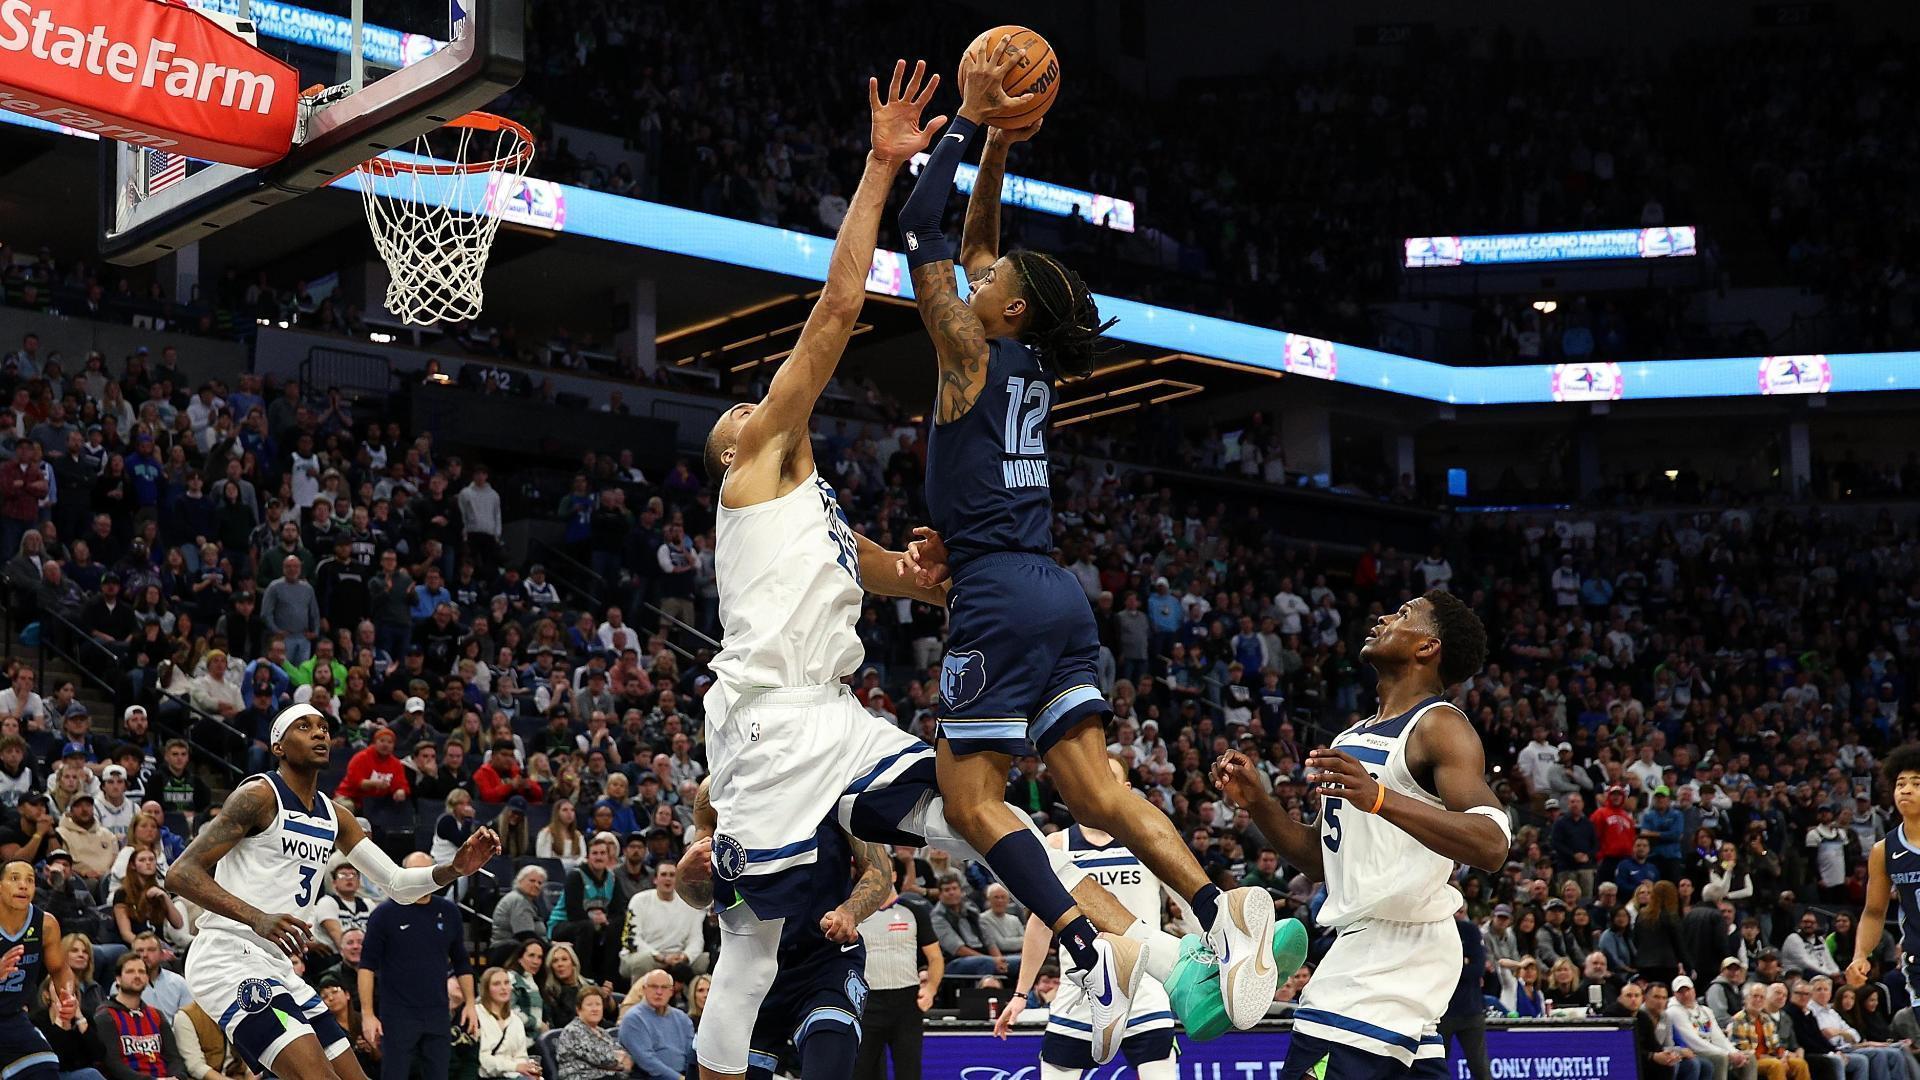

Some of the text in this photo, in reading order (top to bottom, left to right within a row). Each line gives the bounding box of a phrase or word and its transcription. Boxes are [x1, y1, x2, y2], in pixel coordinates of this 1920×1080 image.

[336, 20, 400, 48] PATNER
[1004, 376, 1050, 455] 12
[1003, 460, 1050, 488] MORANT
[1323, 796, 1343, 854] 5
[295, 864, 318, 908] 3
[1489, 1057, 1532, 1079] ONLY
[1534, 1056, 1593, 1078] WORTH
[1596, 1056, 1611, 1077] IT
